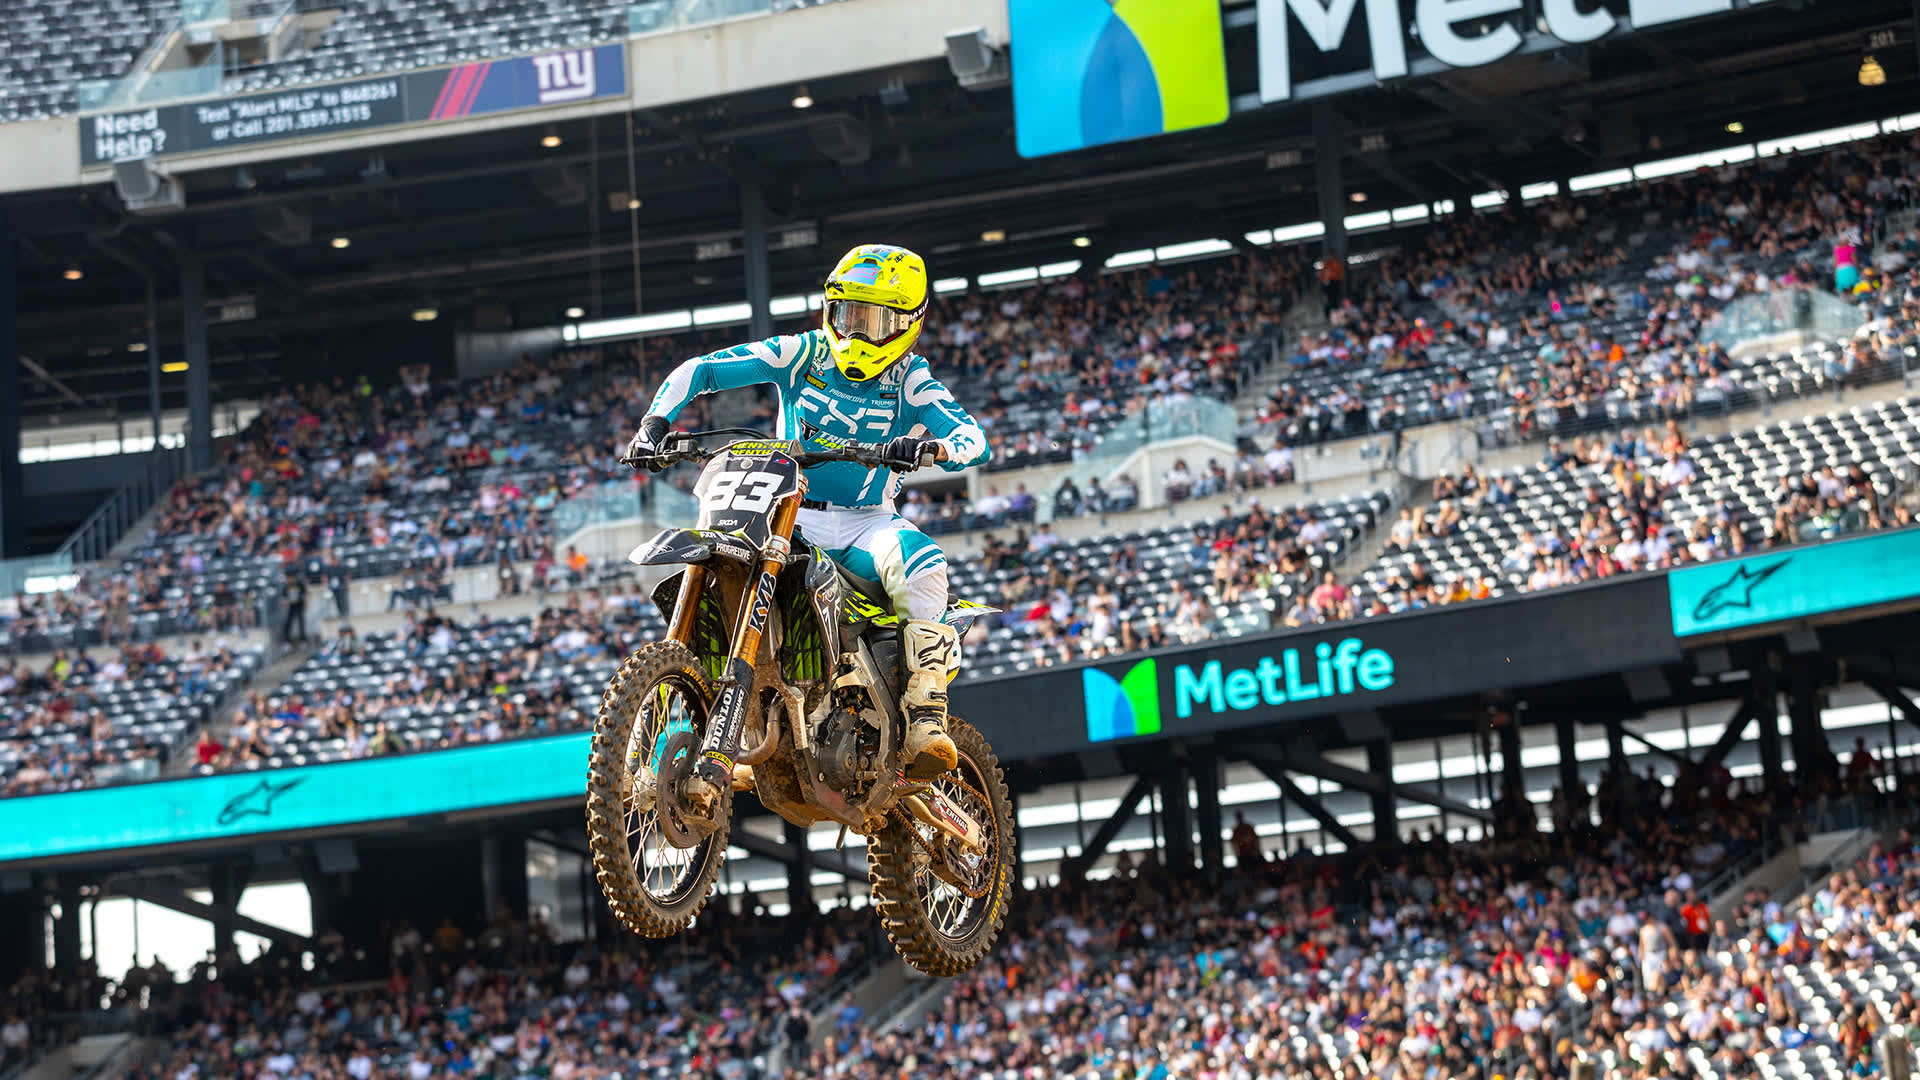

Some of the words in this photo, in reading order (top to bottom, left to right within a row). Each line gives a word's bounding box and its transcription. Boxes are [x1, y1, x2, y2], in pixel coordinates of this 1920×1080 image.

[95, 109, 158, 136] Need
[197, 105, 231, 124] Text
[321, 92, 340, 108] to
[95, 129, 167, 159] Help?
[211, 125, 231, 141] or
[231, 118, 263, 138] Call
[704, 470, 785, 514] 83
[1175, 638, 1395, 718] MetLife
